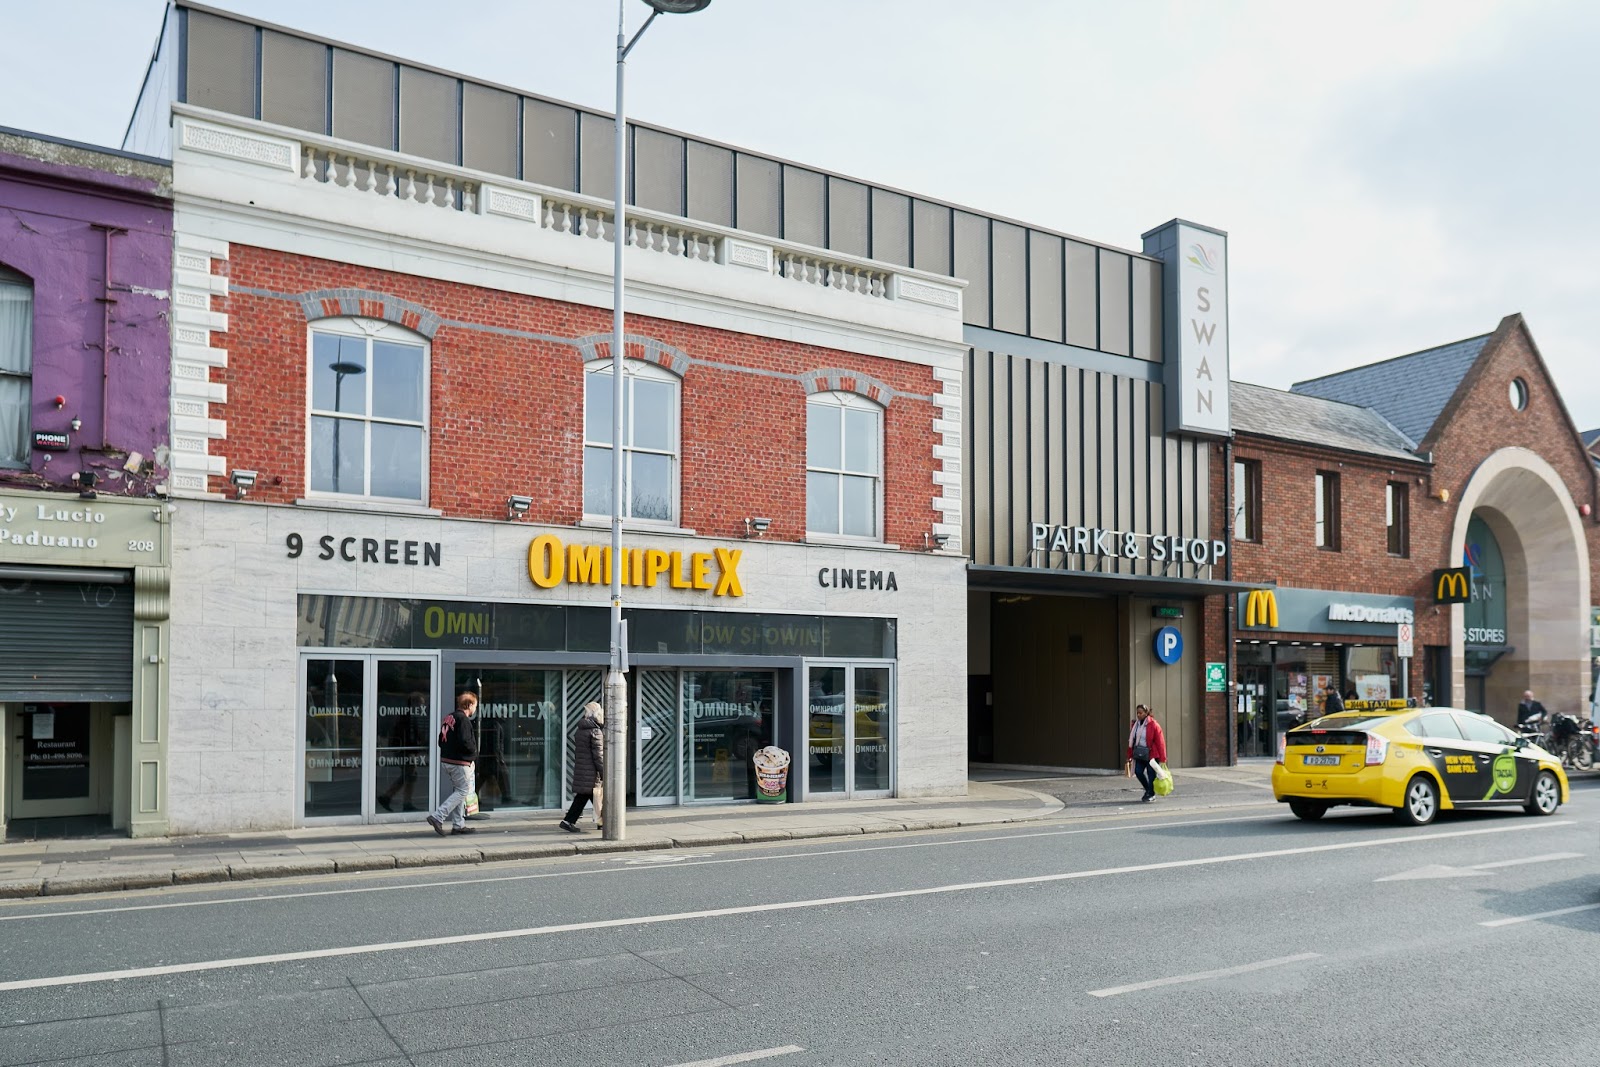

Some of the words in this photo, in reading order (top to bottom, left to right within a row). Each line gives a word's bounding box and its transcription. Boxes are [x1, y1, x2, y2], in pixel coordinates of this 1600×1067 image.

[1191, 286, 1217, 415] SWAN
[36, 434, 66, 443] PHONE
[37, 504, 106, 523] Lucio
[0, 528, 98, 548] Paduano
[1028, 522, 1109, 556] PARK
[1122, 532, 1139, 558] &
[1152, 535, 1226, 565] SHOP
[128, 540, 154, 552] 208
[286, 532, 304, 559] 9
[318, 535, 442, 567] SCREEN
[528, 534, 744, 597] OMNIPLEX
[818, 567, 898, 592] CINEMA
[1329, 603, 1414, 624] McDonald's
[685, 624, 735, 645] NOW
[1468, 628, 1505, 643] STORES
[1164, 633, 1178, 657] P
[309, 705, 360, 718] OMNIPLEX
[379, 705, 428, 717] OMNIPLEX
[468, 701, 549, 721] MNIPLEX
[693, 700, 763, 719] OMNIPLEX
[809, 703, 843, 715] OMNIPLEX
[855, 702, 887, 714] OMNIPLEX
[1369, 700, 1388, 709] TAXI
[37, 741, 76, 749] Restaurant
[809, 744, 843, 756] OMNIPLEX
[855, 743, 887, 754] OMNIPLEX
[308, 756, 360, 769] OMNIPLEX
[378, 755, 427, 767] OMNIPLEX
